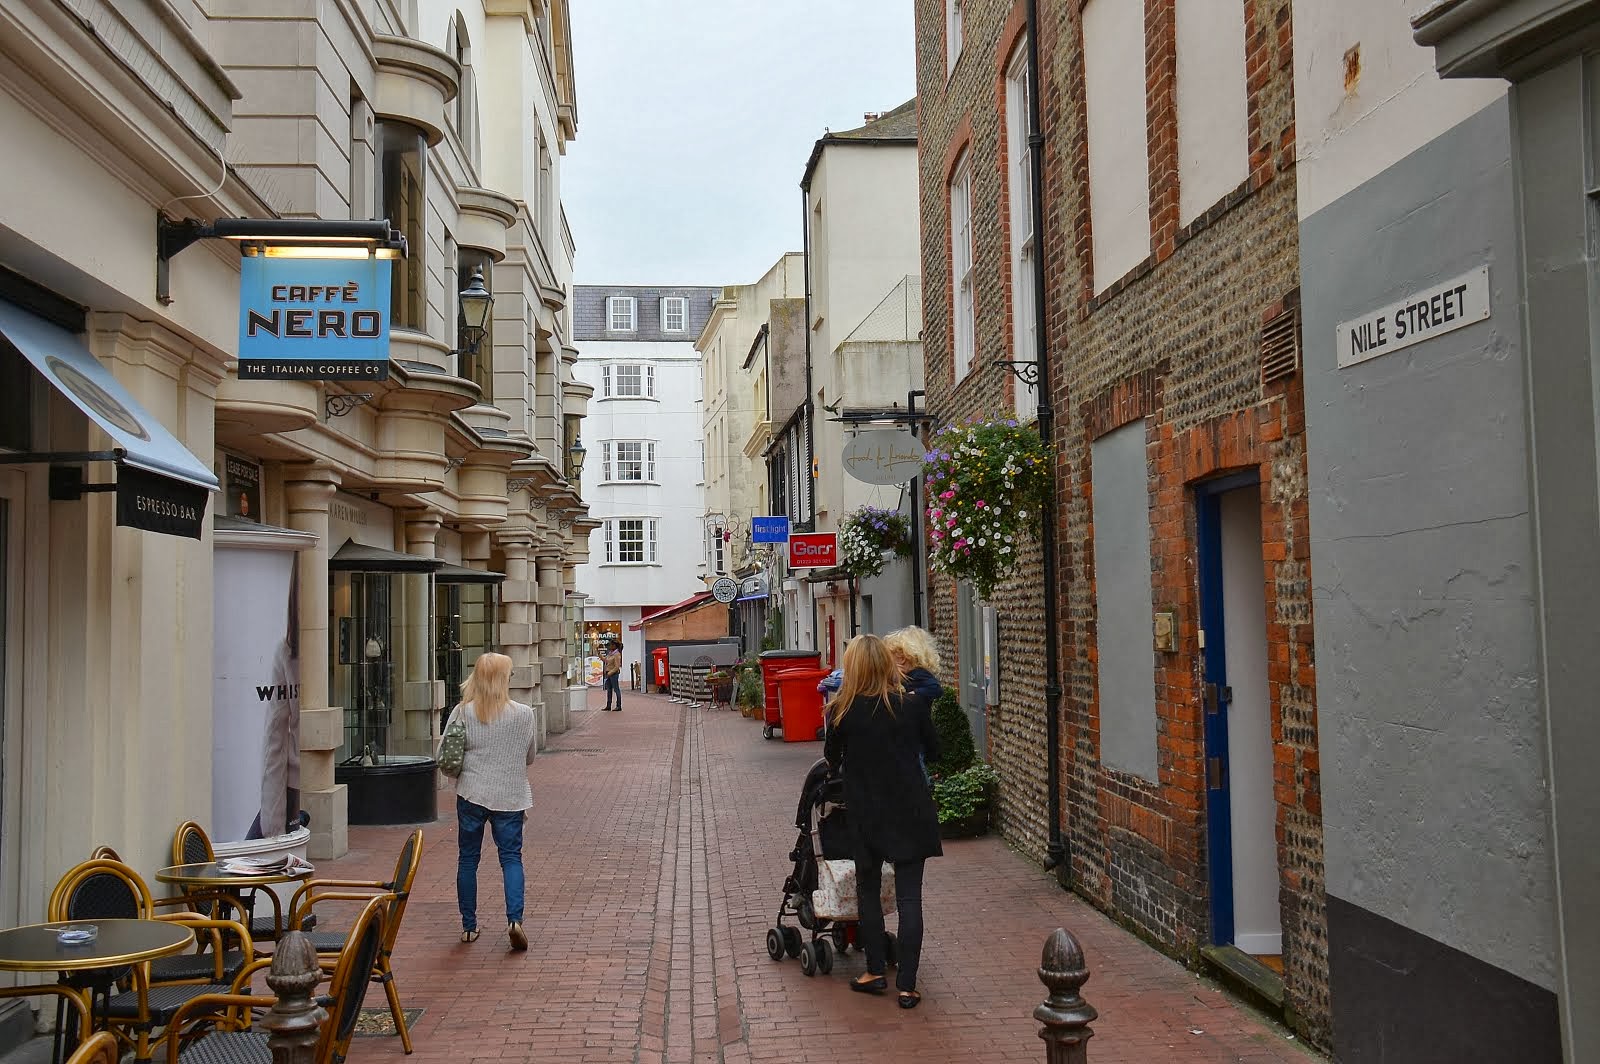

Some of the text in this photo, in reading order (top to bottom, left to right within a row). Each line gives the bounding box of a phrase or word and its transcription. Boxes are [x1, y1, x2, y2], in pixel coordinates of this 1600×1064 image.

[272, 281, 359, 303] CAFFÈ
[247, 308, 381, 338] NERO
[1350, 284, 1467, 355] NILE STREET
[247, 365, 266, 373] THE
[272, 365, 314, 373] ITALIAN
[319, 365, 360, 374] COFFEE
[227, 459, 241, 476] LEASE
[136, 495, 197, 521] ESPRESSO BAR
[329, 503, 349, 522] KAREN
[256, 684, 301, 701] WHIS
